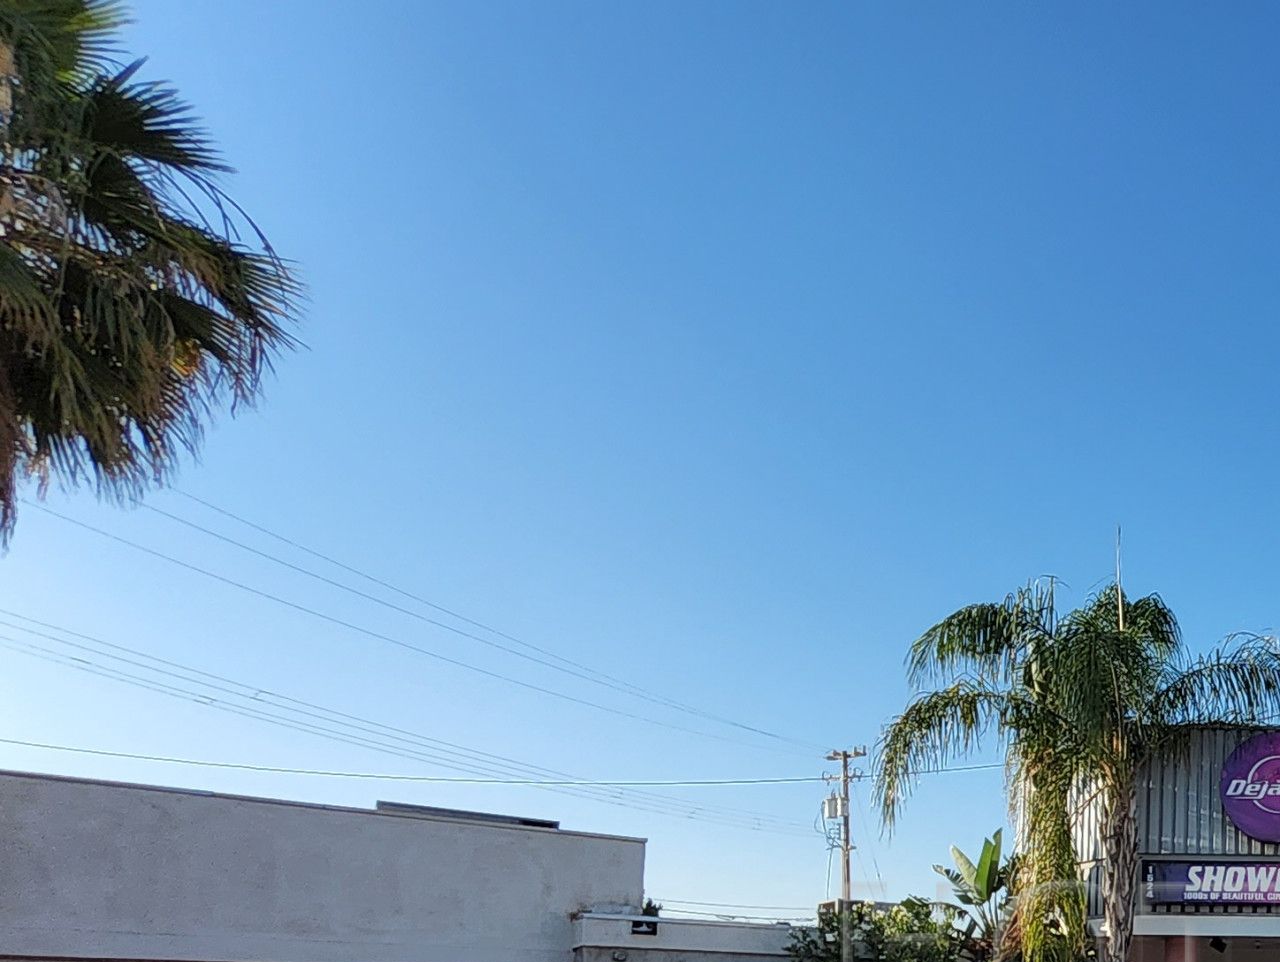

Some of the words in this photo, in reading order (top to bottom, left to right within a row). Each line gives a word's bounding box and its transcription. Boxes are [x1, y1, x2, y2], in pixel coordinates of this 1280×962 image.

[1146, 866, 1154, 898] 1524
[1210, 892, 1221, 900] OF
[1222, 892, 1265, 900] BEAUTIFUL
